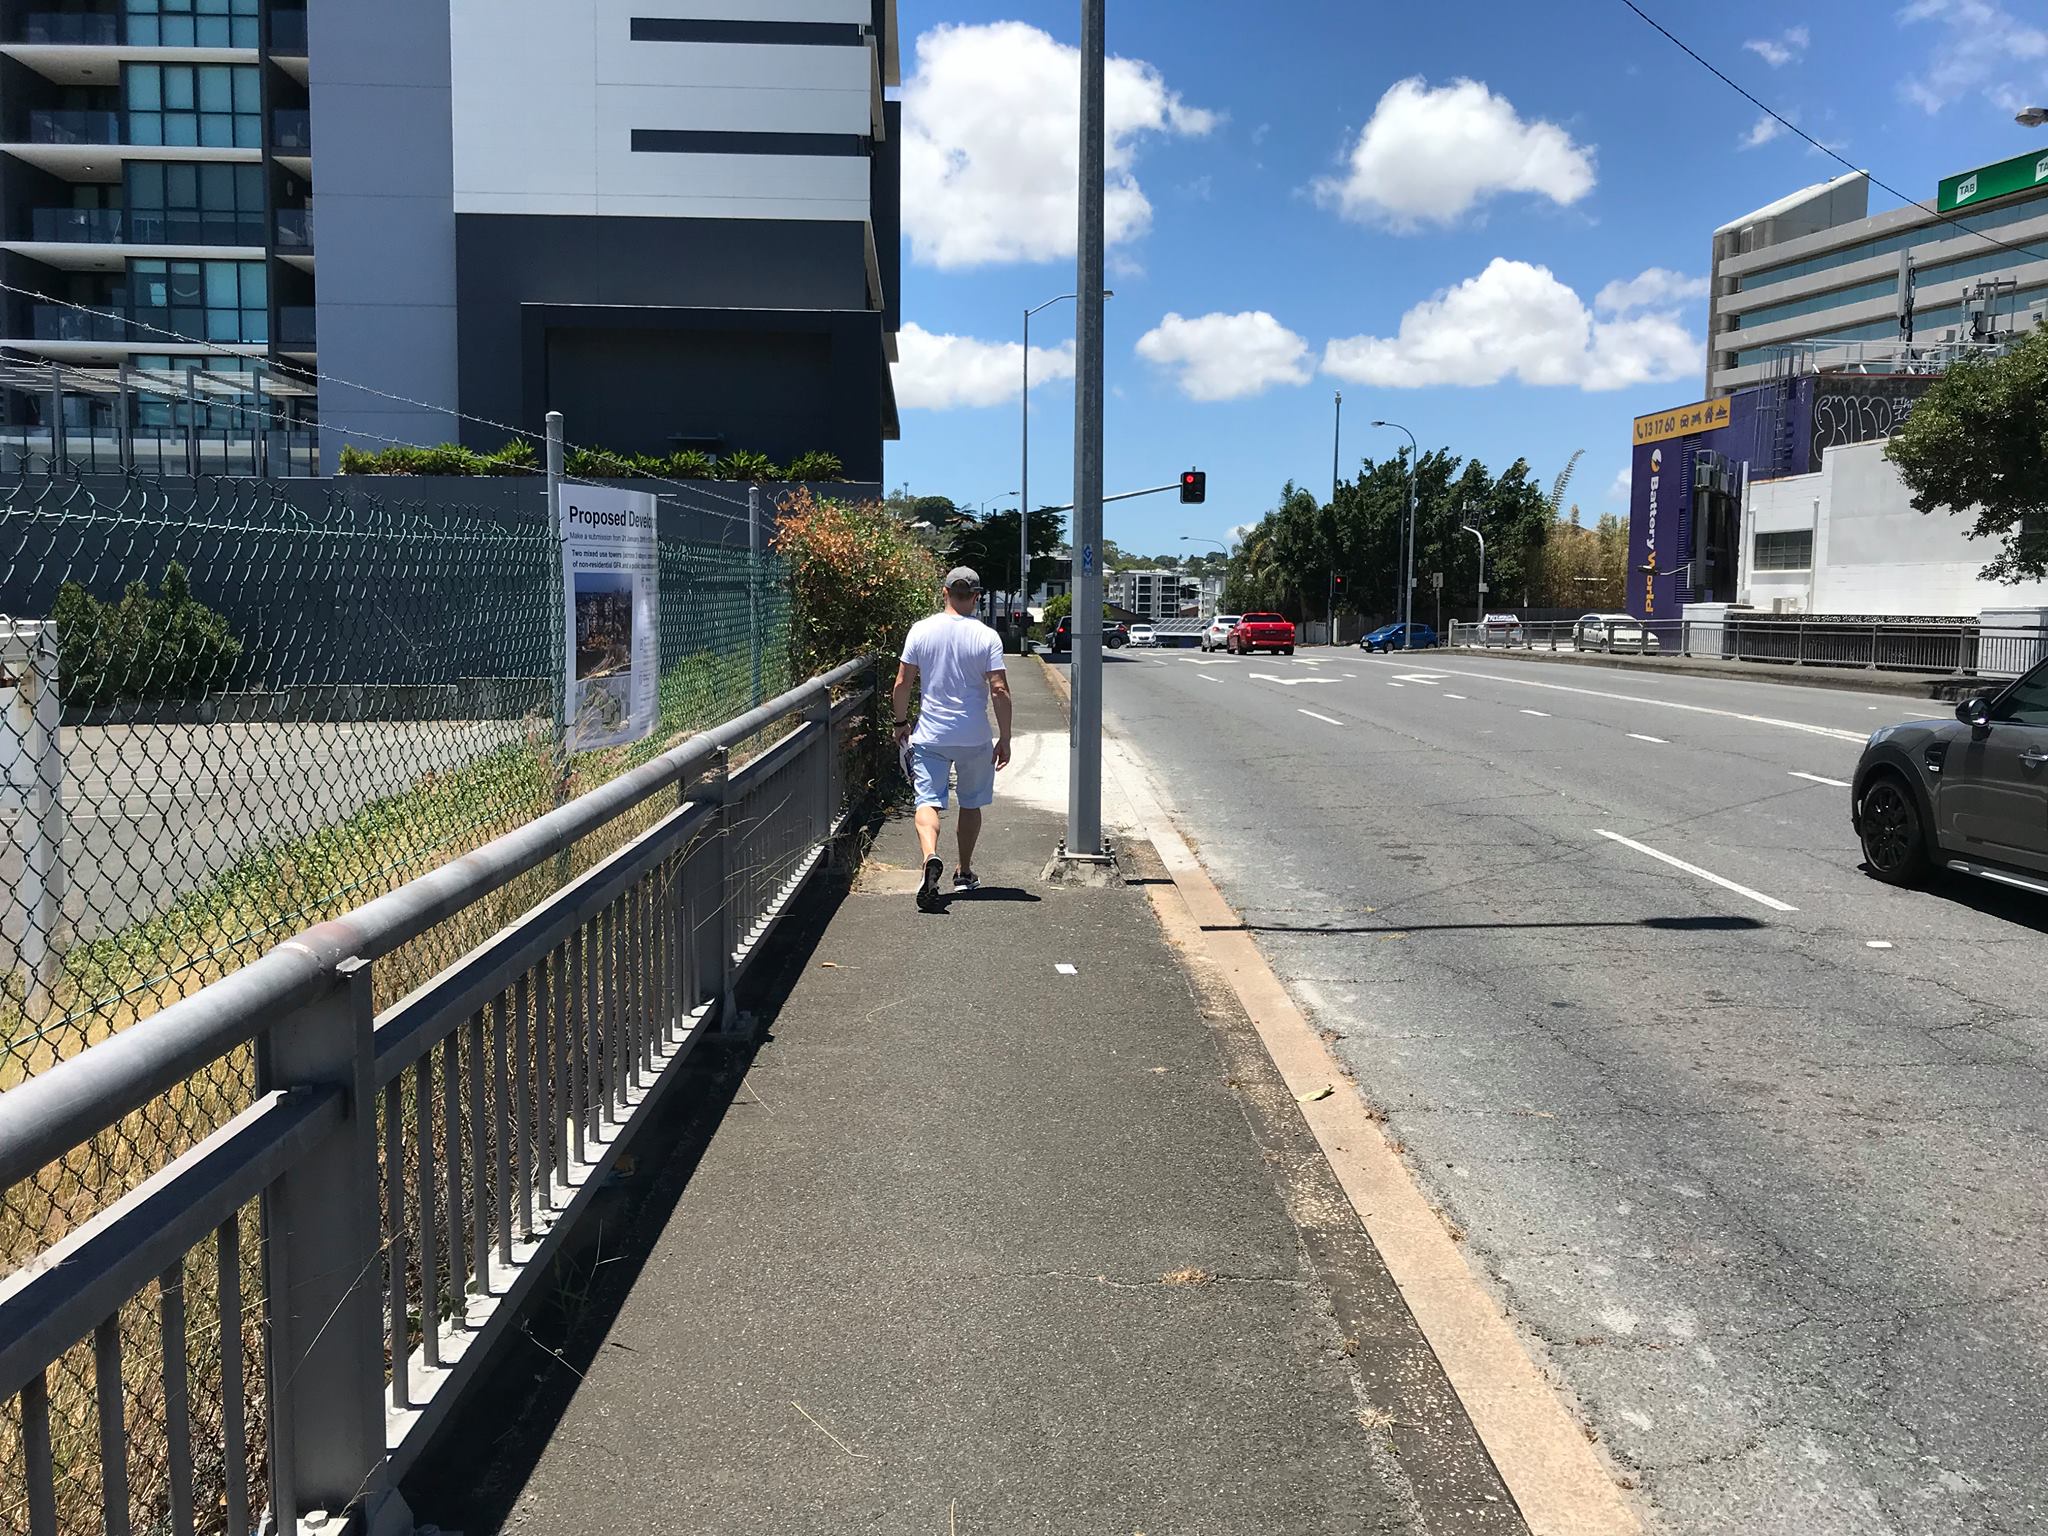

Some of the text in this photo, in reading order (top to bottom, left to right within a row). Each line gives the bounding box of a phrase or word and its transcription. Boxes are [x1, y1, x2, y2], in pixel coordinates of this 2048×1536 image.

[1959, 183, 1975, 195] TAB
[1644, 416, 1675, 438] 13 17 60
[569, 505, 627, 528] Proposed
[569, 532, 583, 540] Make
[1645, 475, 1660, 613] Battery World
[571, 549, 583, 557] Two
[583, 550, 598, 558] mixed
[608, 551, 622, 559] towers
[572, 560, 578, 568] of
[579, 561, 612, 569] non-residential
